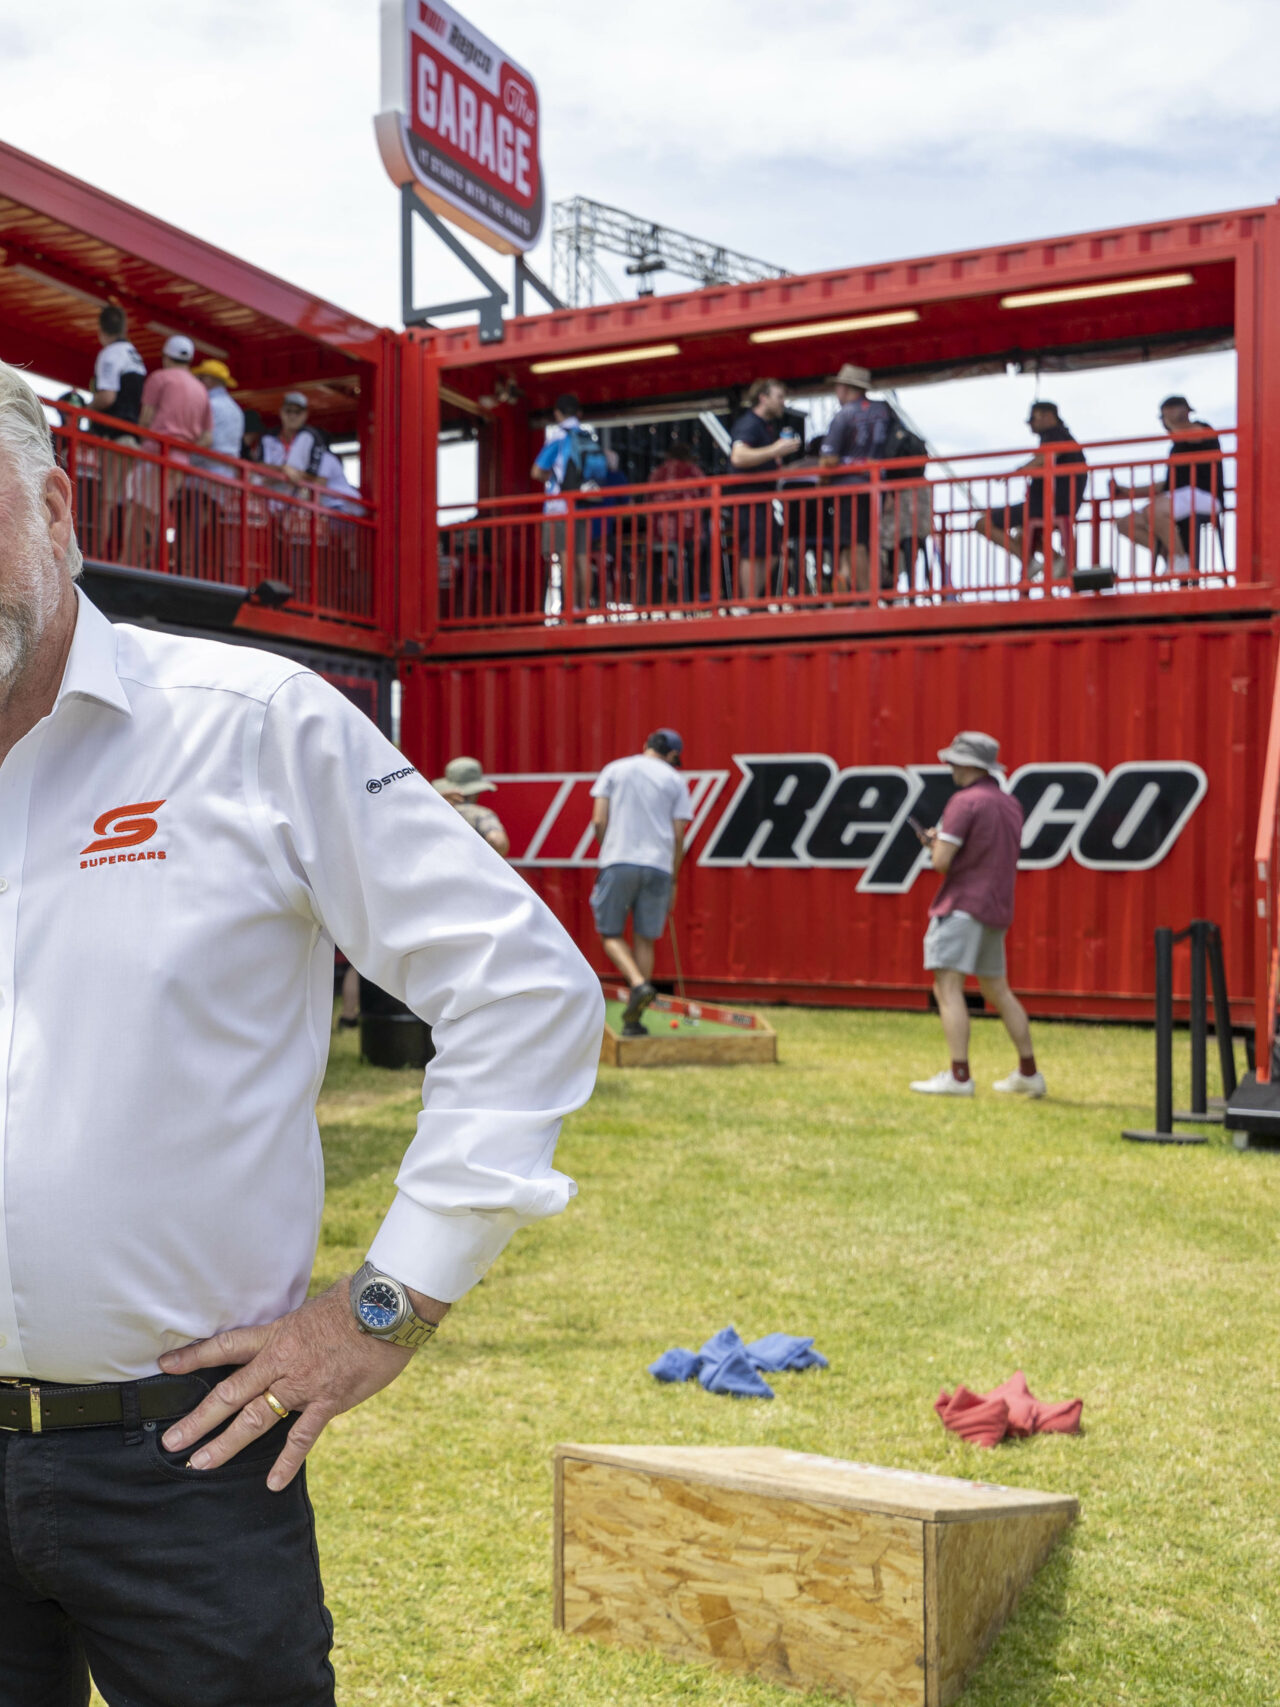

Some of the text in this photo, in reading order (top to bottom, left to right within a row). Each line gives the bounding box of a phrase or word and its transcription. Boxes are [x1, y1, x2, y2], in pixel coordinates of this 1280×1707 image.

[448, 22, 493, 77] Repco
[416, 52, 532, 199] GARAGE
[503, 78, 536, 128] The
[79, 850, 167, 870] SUPERCARS
